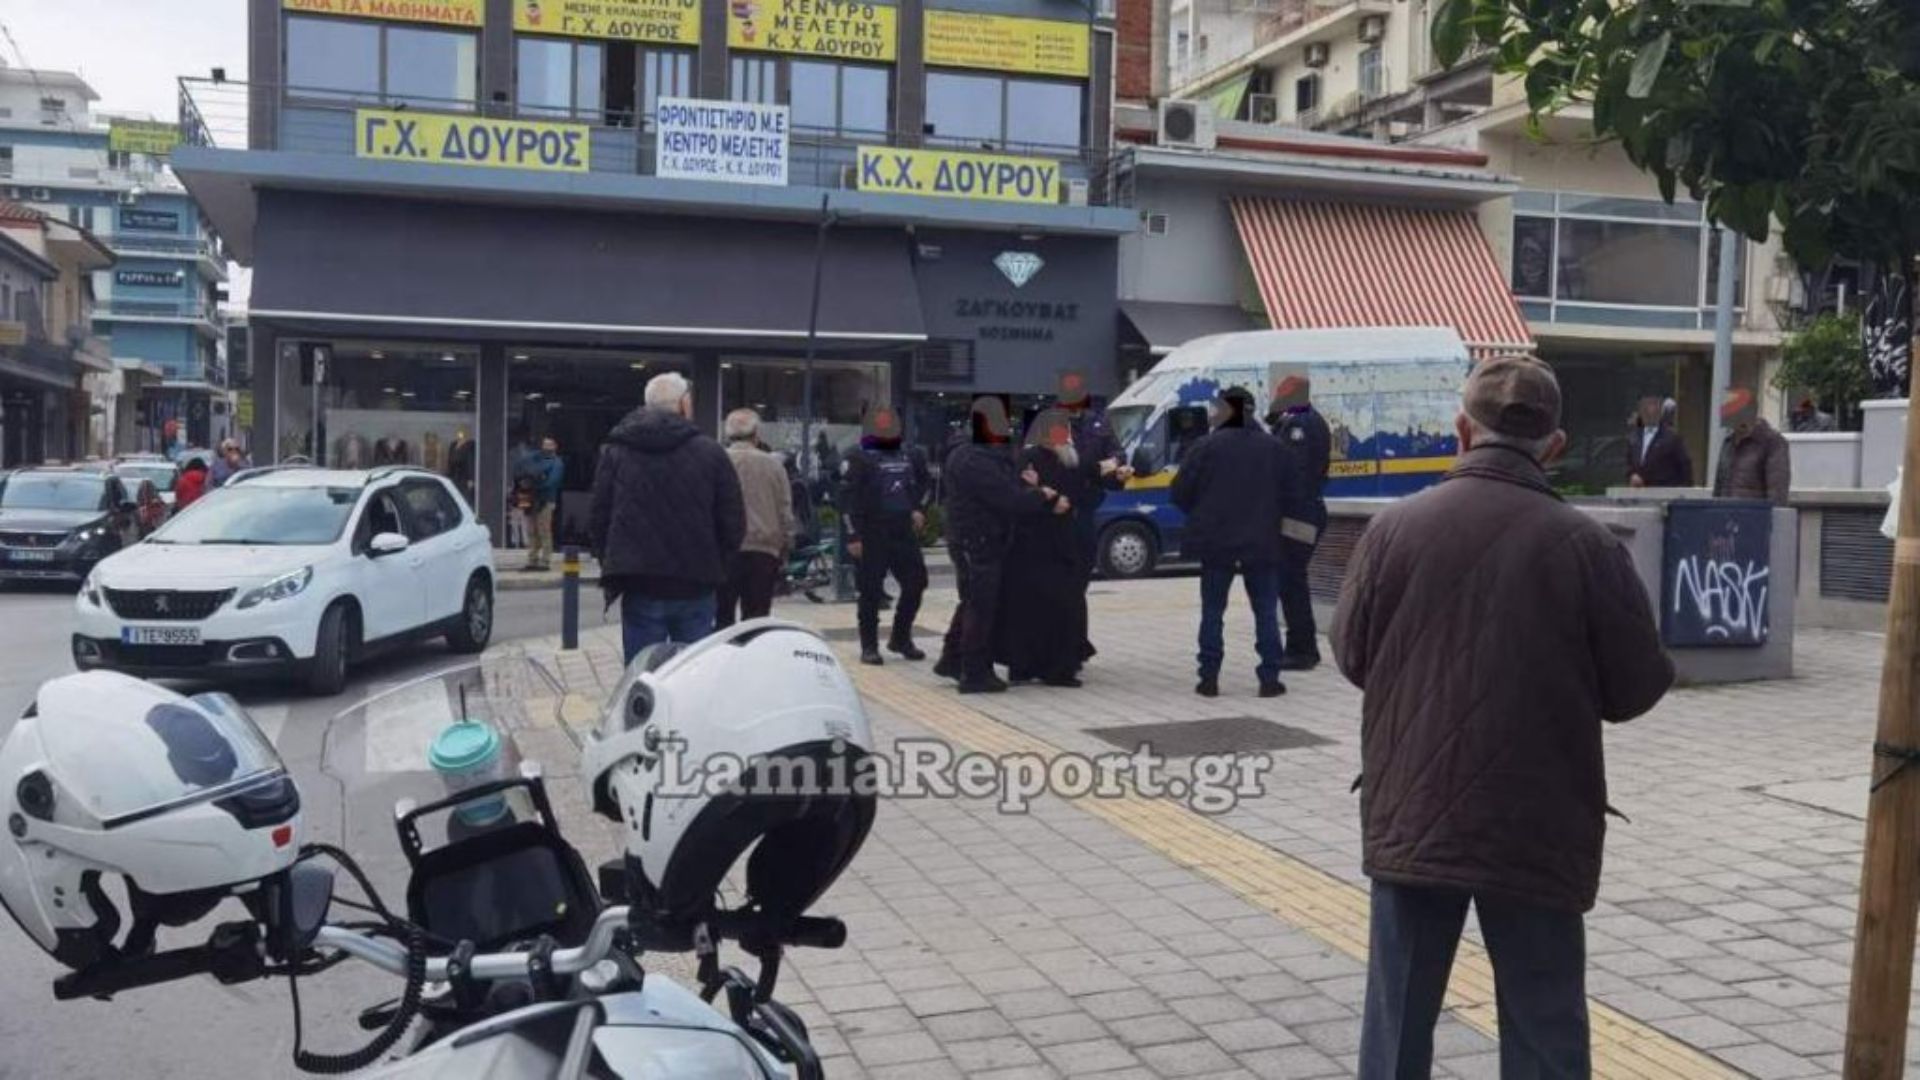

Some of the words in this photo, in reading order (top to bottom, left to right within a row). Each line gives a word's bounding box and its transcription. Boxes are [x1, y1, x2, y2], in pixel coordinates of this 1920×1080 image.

[369, 2, 476, 21] ΜΑΘΗΜΑΤΑ
[783, 0, 875, 20] ΚΕΝΤΡΟ
[607, 20, 681, 40] ΔΟΥΡΟΣ
[774, 15, 882, 38] ΜΕΛΕΤΗΣ
[814, 37, 885, 57] ΔΟΥΡΟΥ
[659, 104, 757, 132] ΦΡΟΝΤΙΣΤΗΡΙΟ
[441, 123, 582, 167] ΔΟΥΡΟΣ
[663, 131, 717, 154] ΚΕΝΤΡΟ
[721, 134, 782, 159] ΜΕΛΕΤΗΣ
[933, 160, 1056, 198] ΔΟΥΡΟΥ
